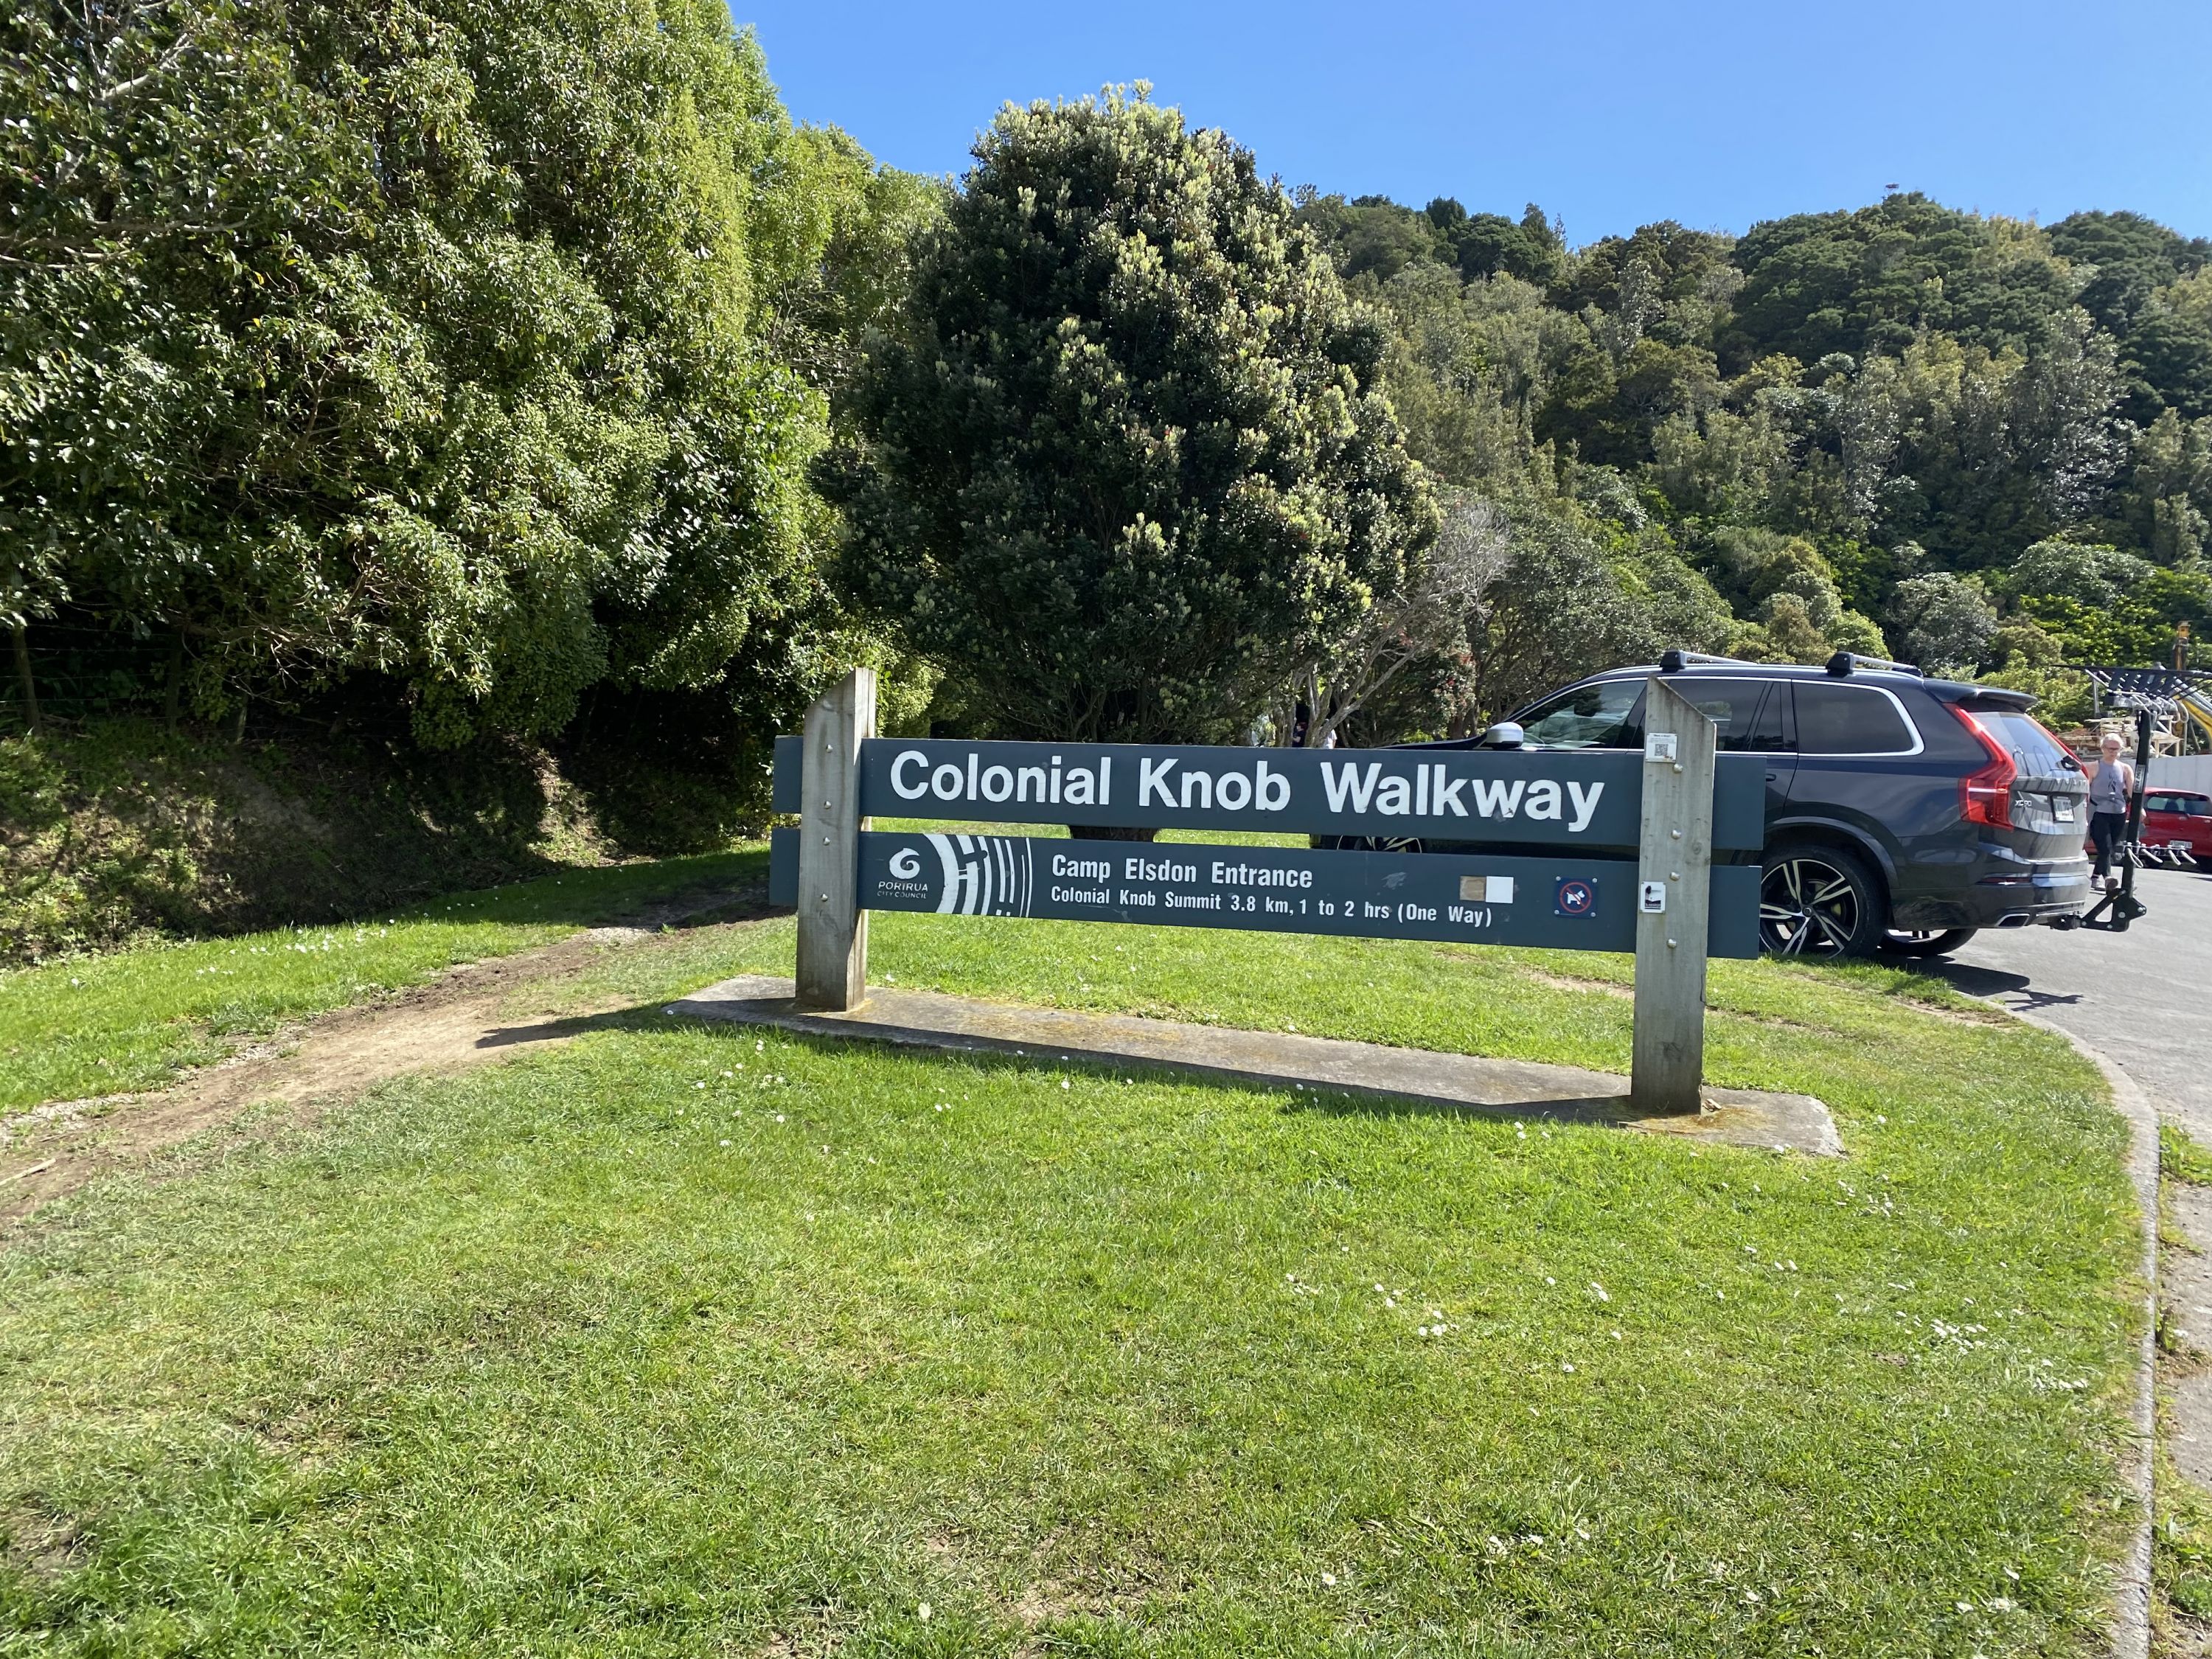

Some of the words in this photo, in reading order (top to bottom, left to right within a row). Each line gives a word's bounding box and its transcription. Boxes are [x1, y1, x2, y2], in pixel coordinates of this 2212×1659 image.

[890, 750, 1111, 805] Colonial
[1138, 757, 1291, 811] Knob
[1320, 762, 1605, 832] Walkway
[878, 881, 928, 891] PORIRUA
[1052, 854, 1111, 883] Camp
[1125, 858, 1197, 883] Elsdon
[1211, 861, 1312, 888] Entrance
[1051, 886, 1110, 904] Colonial
[1119, 889, 1156, 906] Knob
[1164, 891, 1221, 909] Summit
[1231, 894, 1256, 911] 3.8
[1318, 900, 1335, 916] to
[1344, 900, 1354, 917] 2
[1365, 901, 1390, 919] hrs
[1397, 903, 1437, 923] (One
[1448, 905, 1492, 927] Way)
